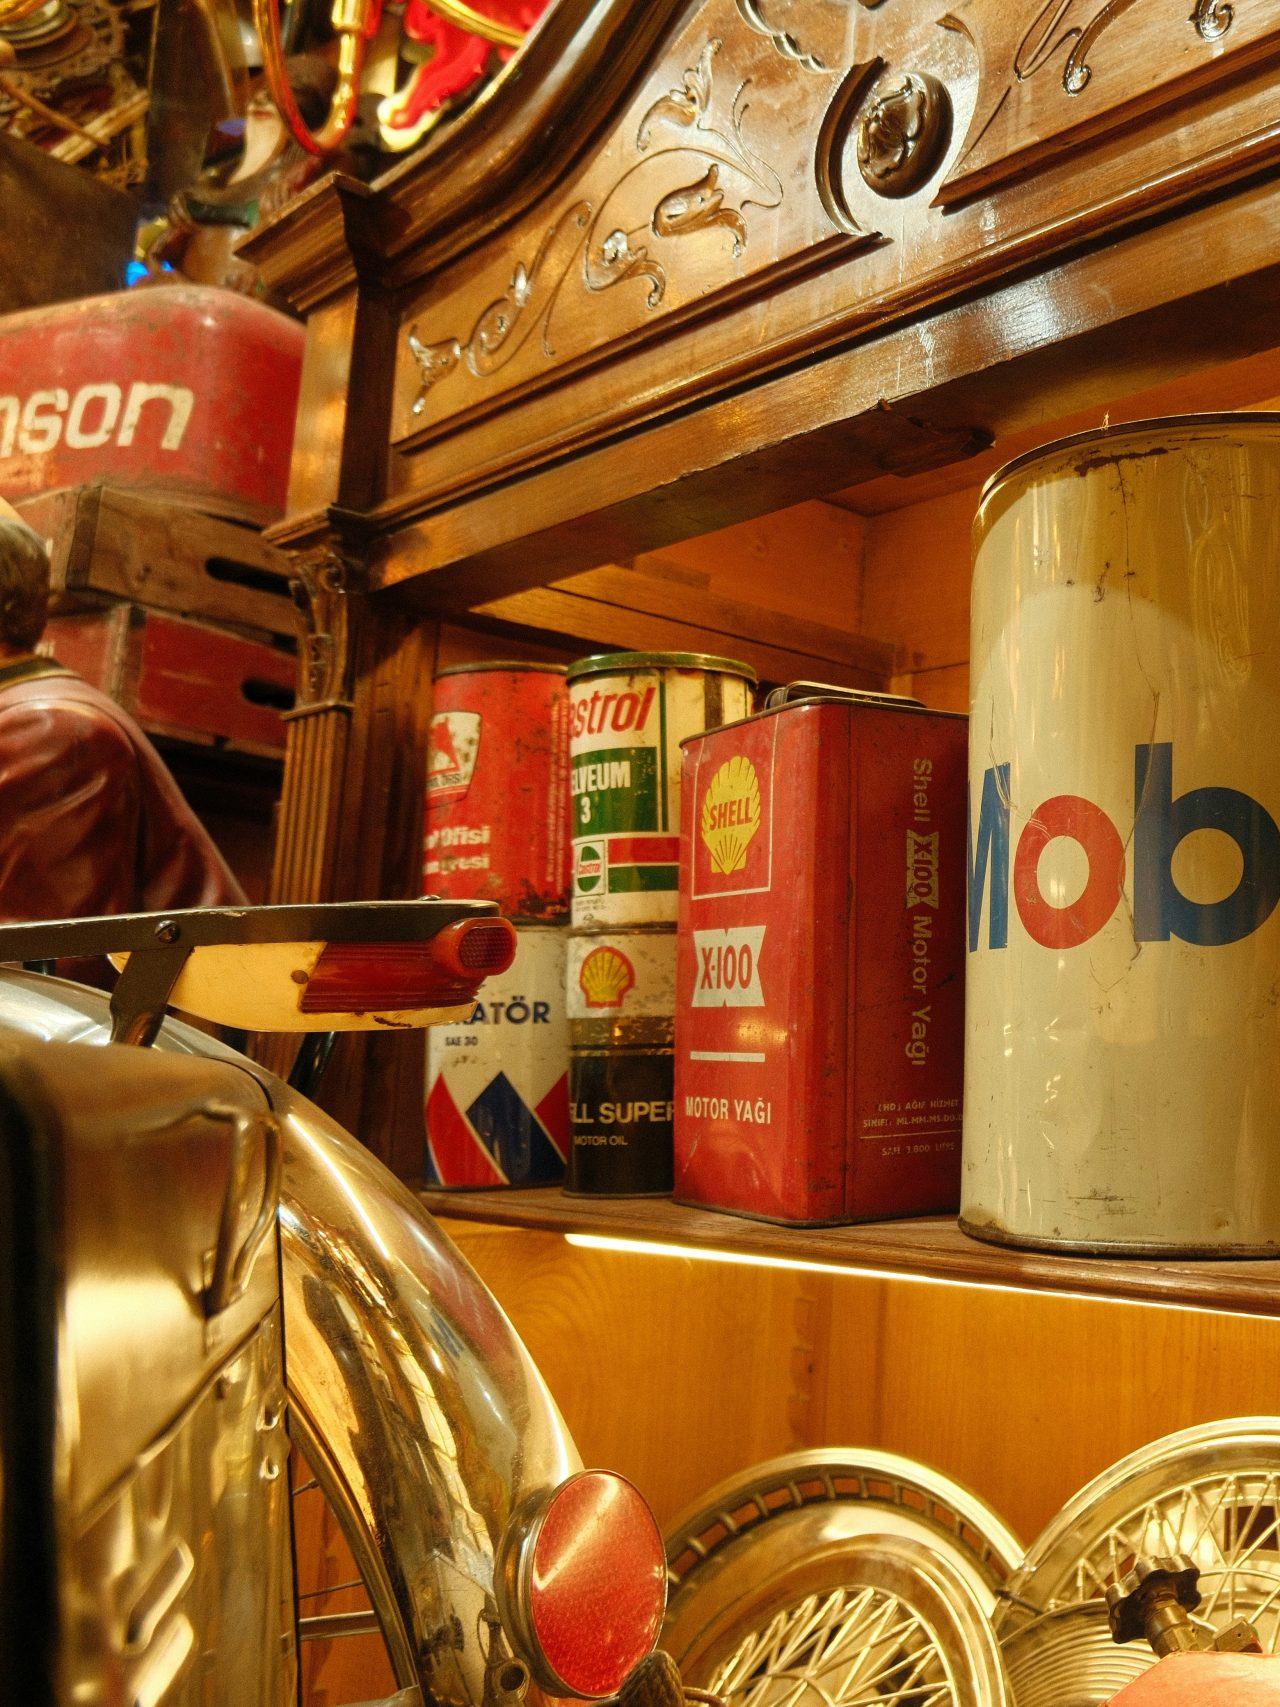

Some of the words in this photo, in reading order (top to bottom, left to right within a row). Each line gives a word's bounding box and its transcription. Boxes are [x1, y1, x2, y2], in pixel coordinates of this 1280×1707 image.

[580, 796, 591, 824] 3
[913, 758, 933, 821] Shell
[709, 797, 753, 831] SHELL
[913, 840, 933, 897] X-100
[701, 943, 753, 990] X-100
[912, 916, 933, 994] Motor
[905, 1005, 931, 1065] Yağı
[686, 1096, 729, 1120] MOTOR
[734, 1097, 771, 1124] YAĞI
[609, 1135, 628, 1146] OIL
